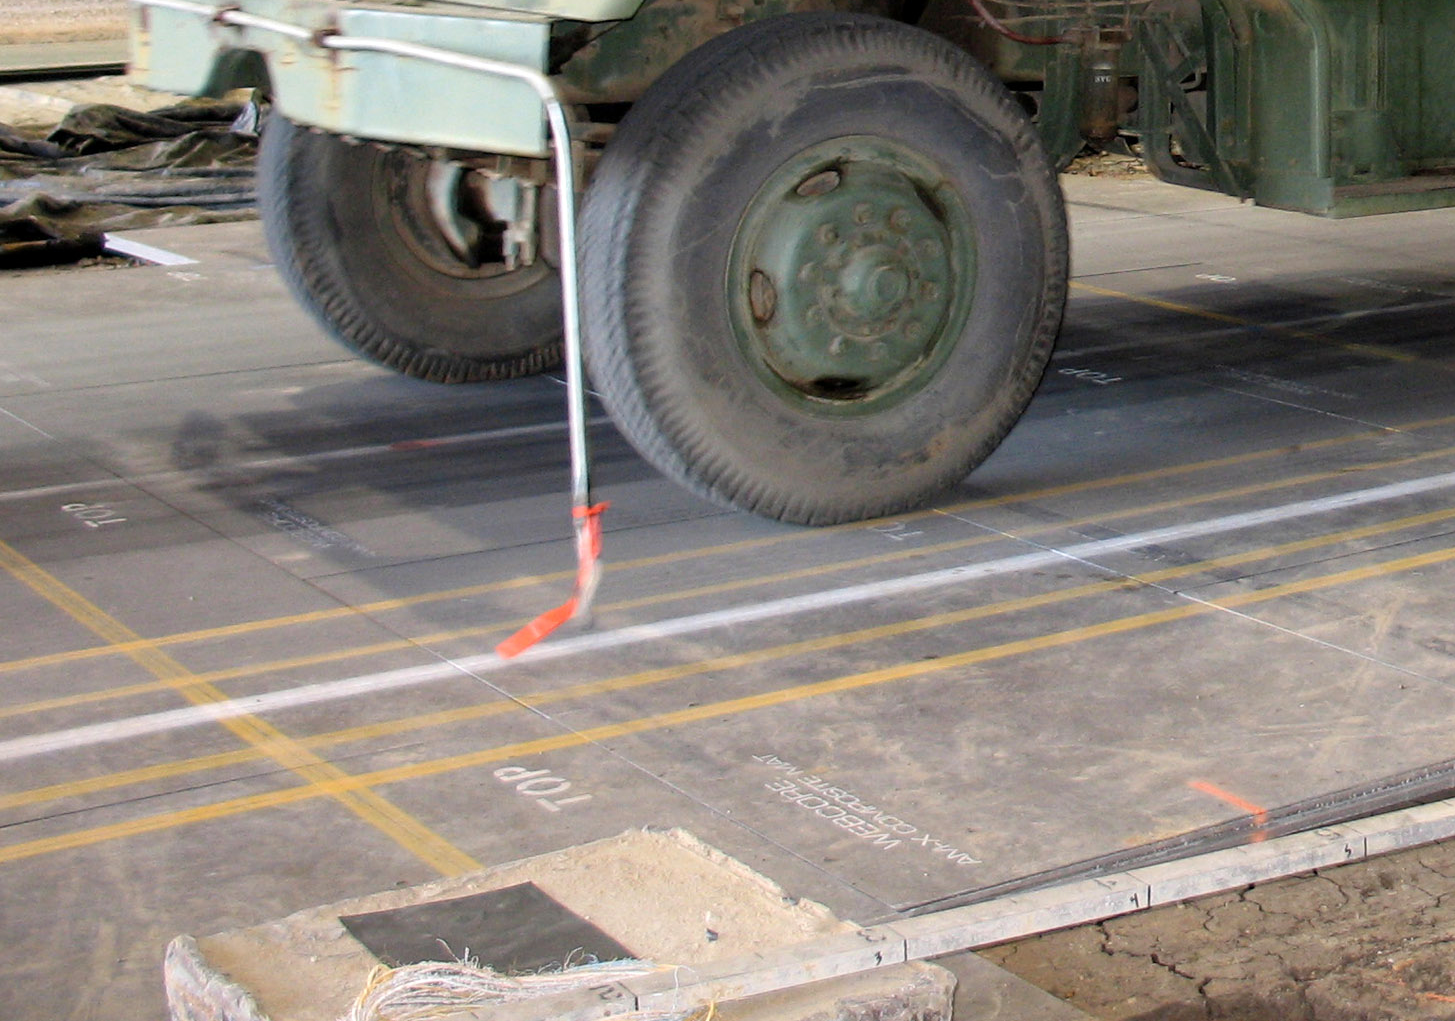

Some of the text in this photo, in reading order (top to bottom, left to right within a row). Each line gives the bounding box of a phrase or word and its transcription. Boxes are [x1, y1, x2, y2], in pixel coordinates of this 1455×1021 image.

[61, 502, 128, 528] TOP
[751, 754, 804, 776] MAT
[492, 766, 593, 812] TOP
[797, 775, 918, 835] COMPOSITE
[764, 777, 902, 850] WEBCORE
